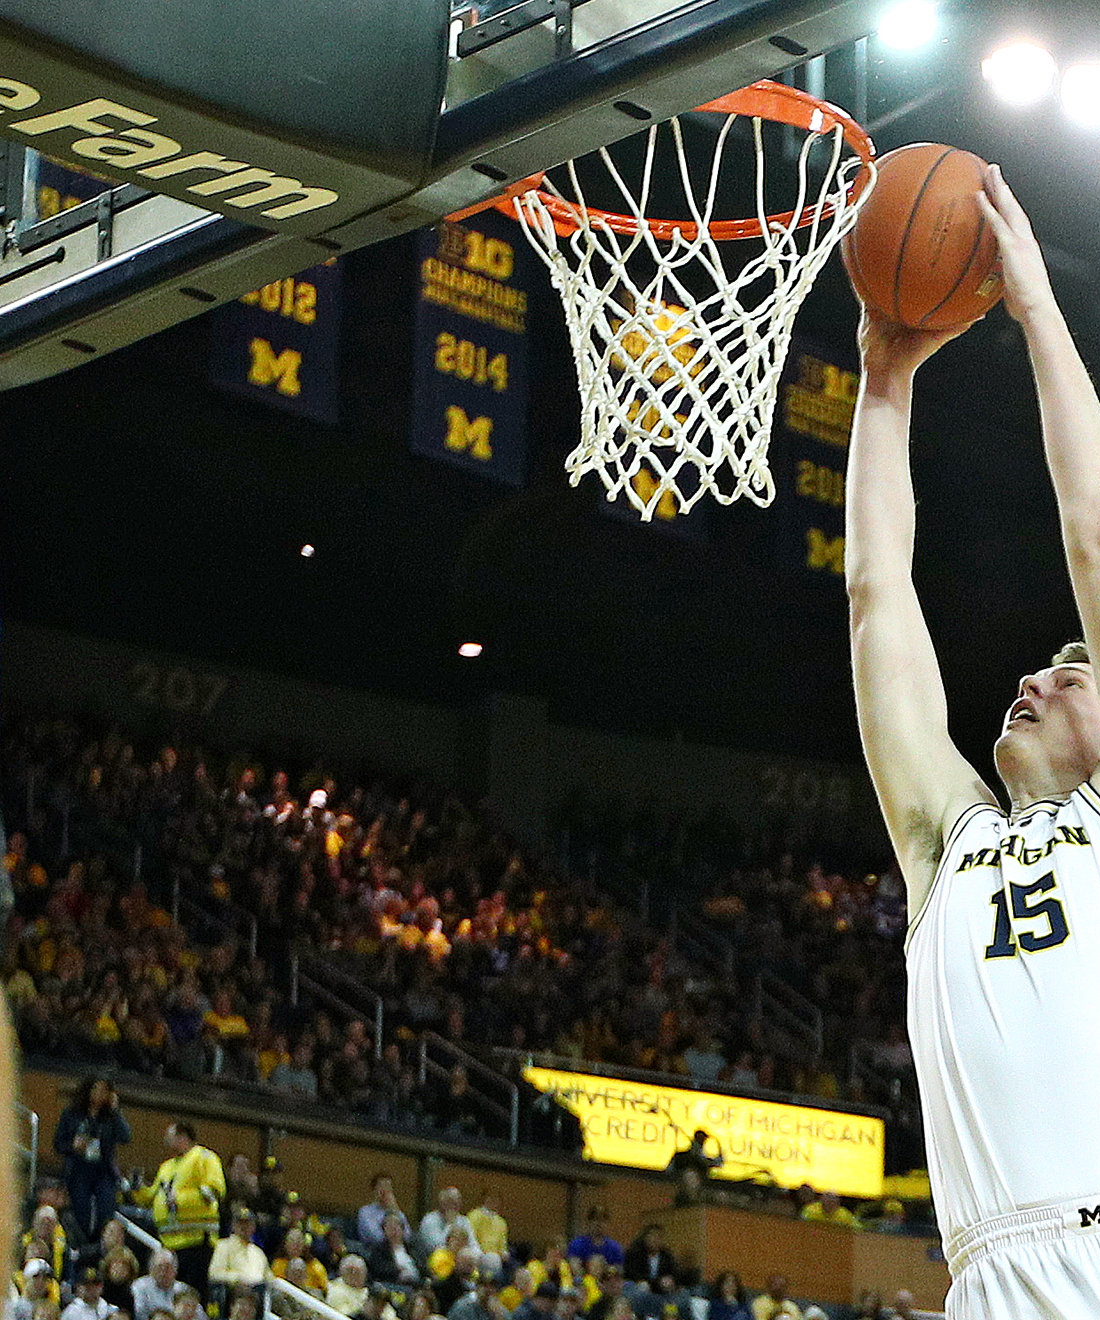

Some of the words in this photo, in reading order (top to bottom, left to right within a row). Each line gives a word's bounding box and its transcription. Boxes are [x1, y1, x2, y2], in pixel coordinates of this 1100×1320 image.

[8, 97, 339, 221] Farm
[248, 337, 302, 396] M
[436, 332, 508, 392] 2014
[446, 405, 493, 460] M
[983, 869, 1071, 961] 15
[705, 1103, 736, 1126] OF
[749, 1108, 877, 1147] MICHIGAN
[728, 1138, 813, 1164] UNION
